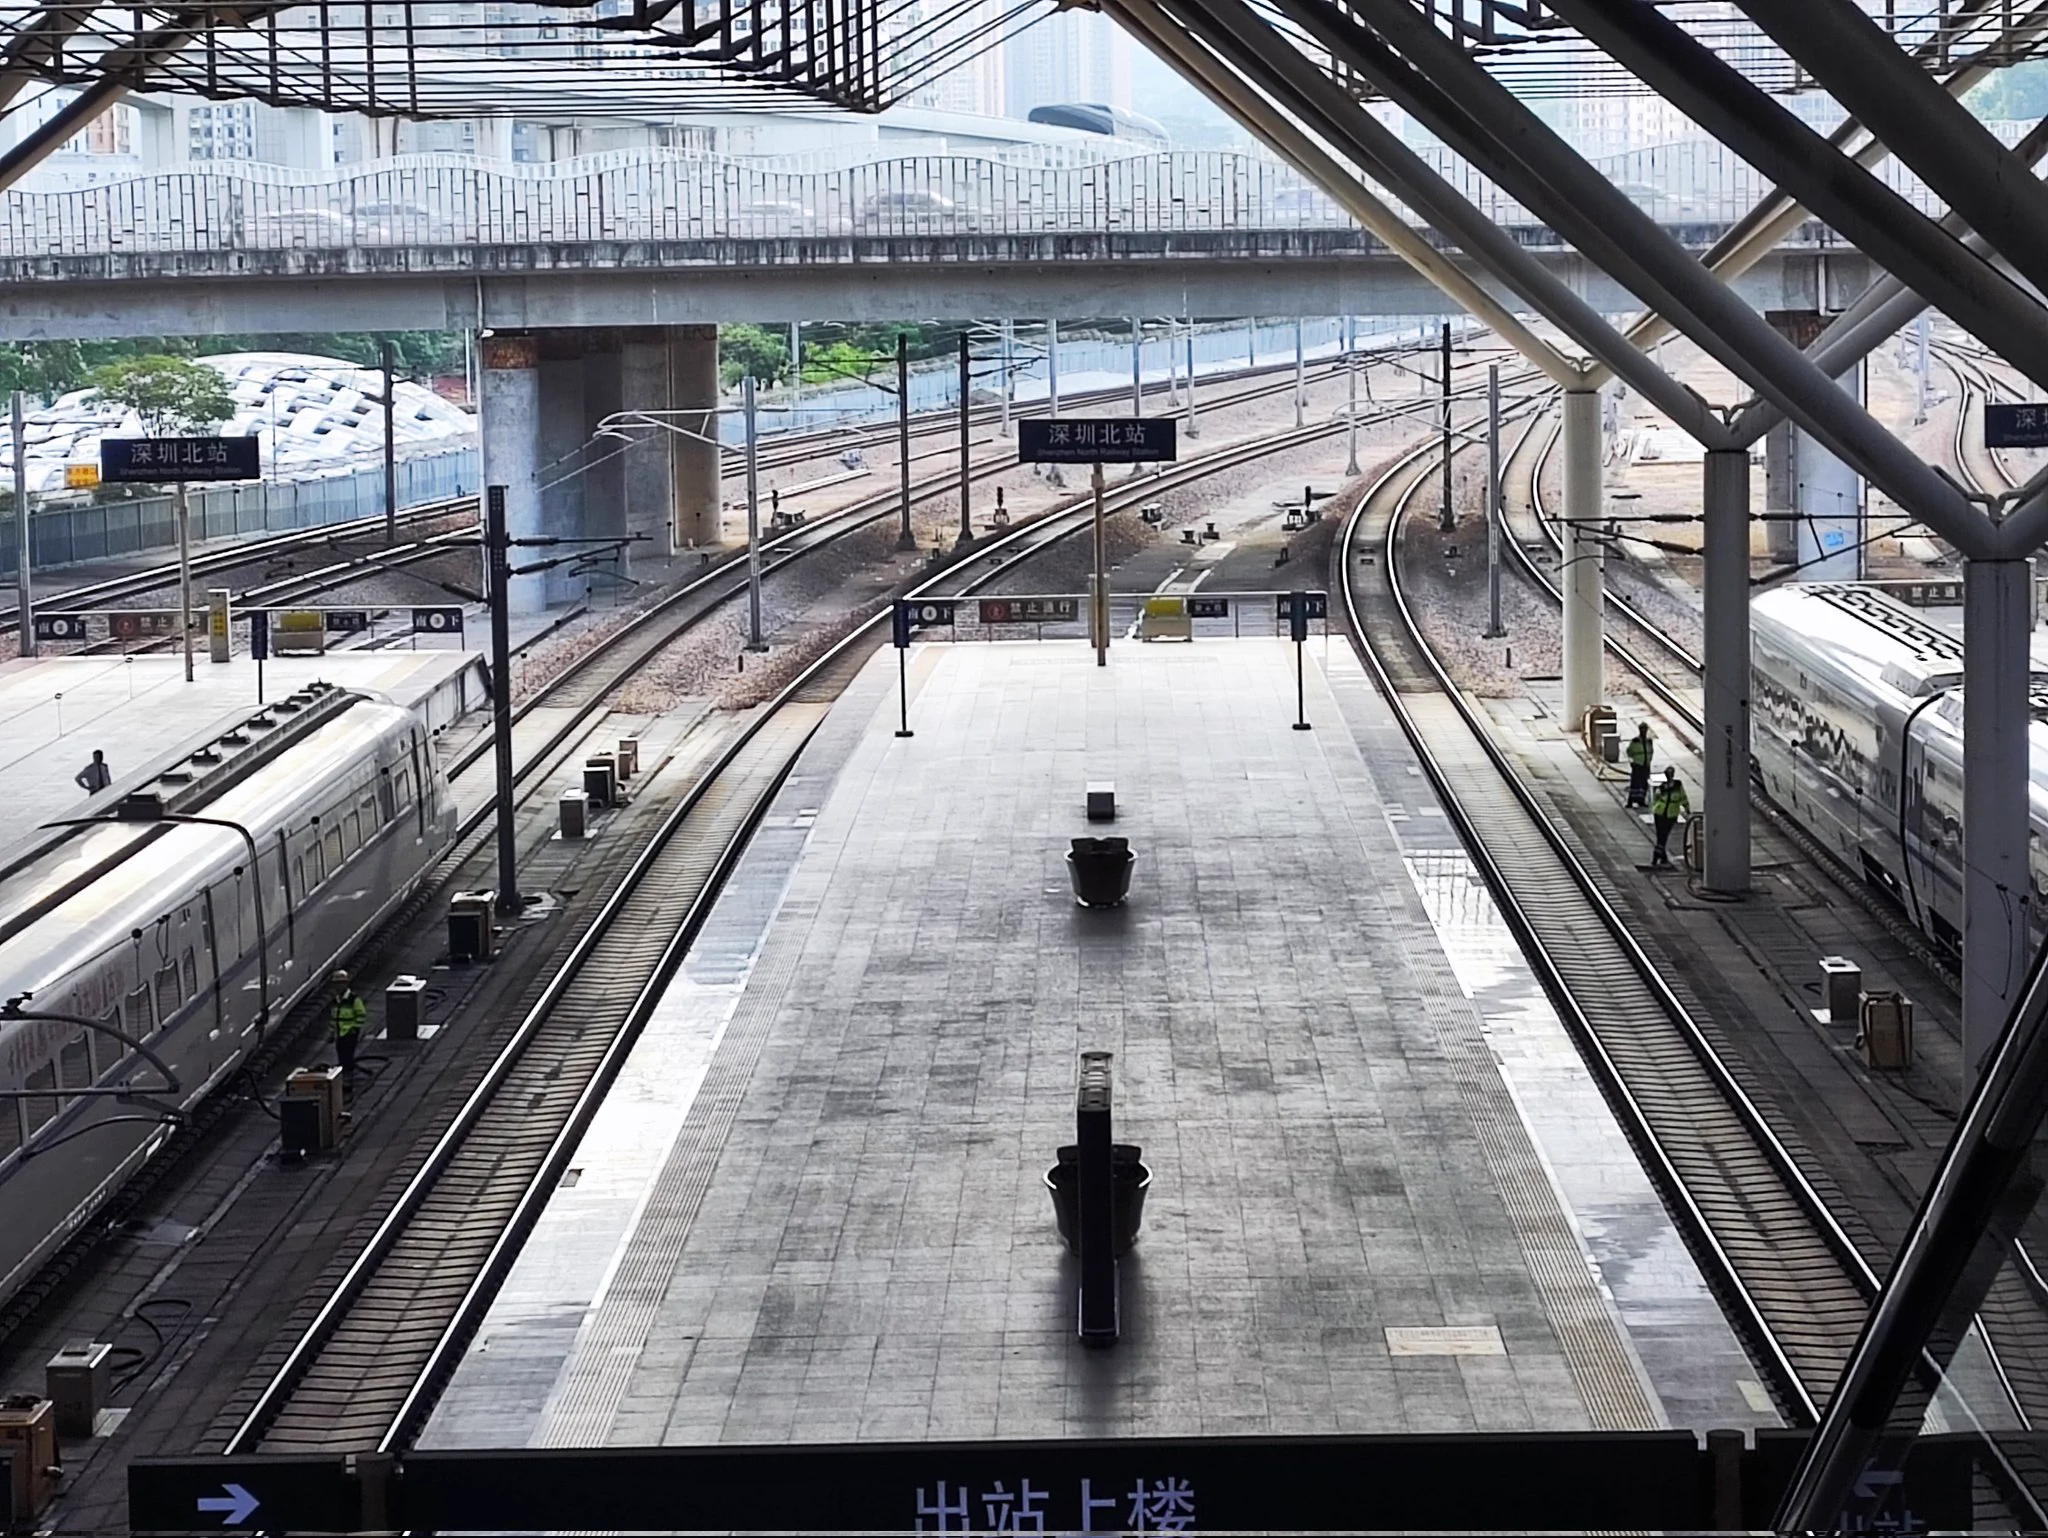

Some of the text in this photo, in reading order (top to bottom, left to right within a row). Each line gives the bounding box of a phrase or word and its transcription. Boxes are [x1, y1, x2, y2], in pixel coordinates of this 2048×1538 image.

[1049, 423, 1147, 445] 深圳北站
[131, 442, 228, 464] 深圳北站
[914, 1477, 1197, 1538] 出站上楼
